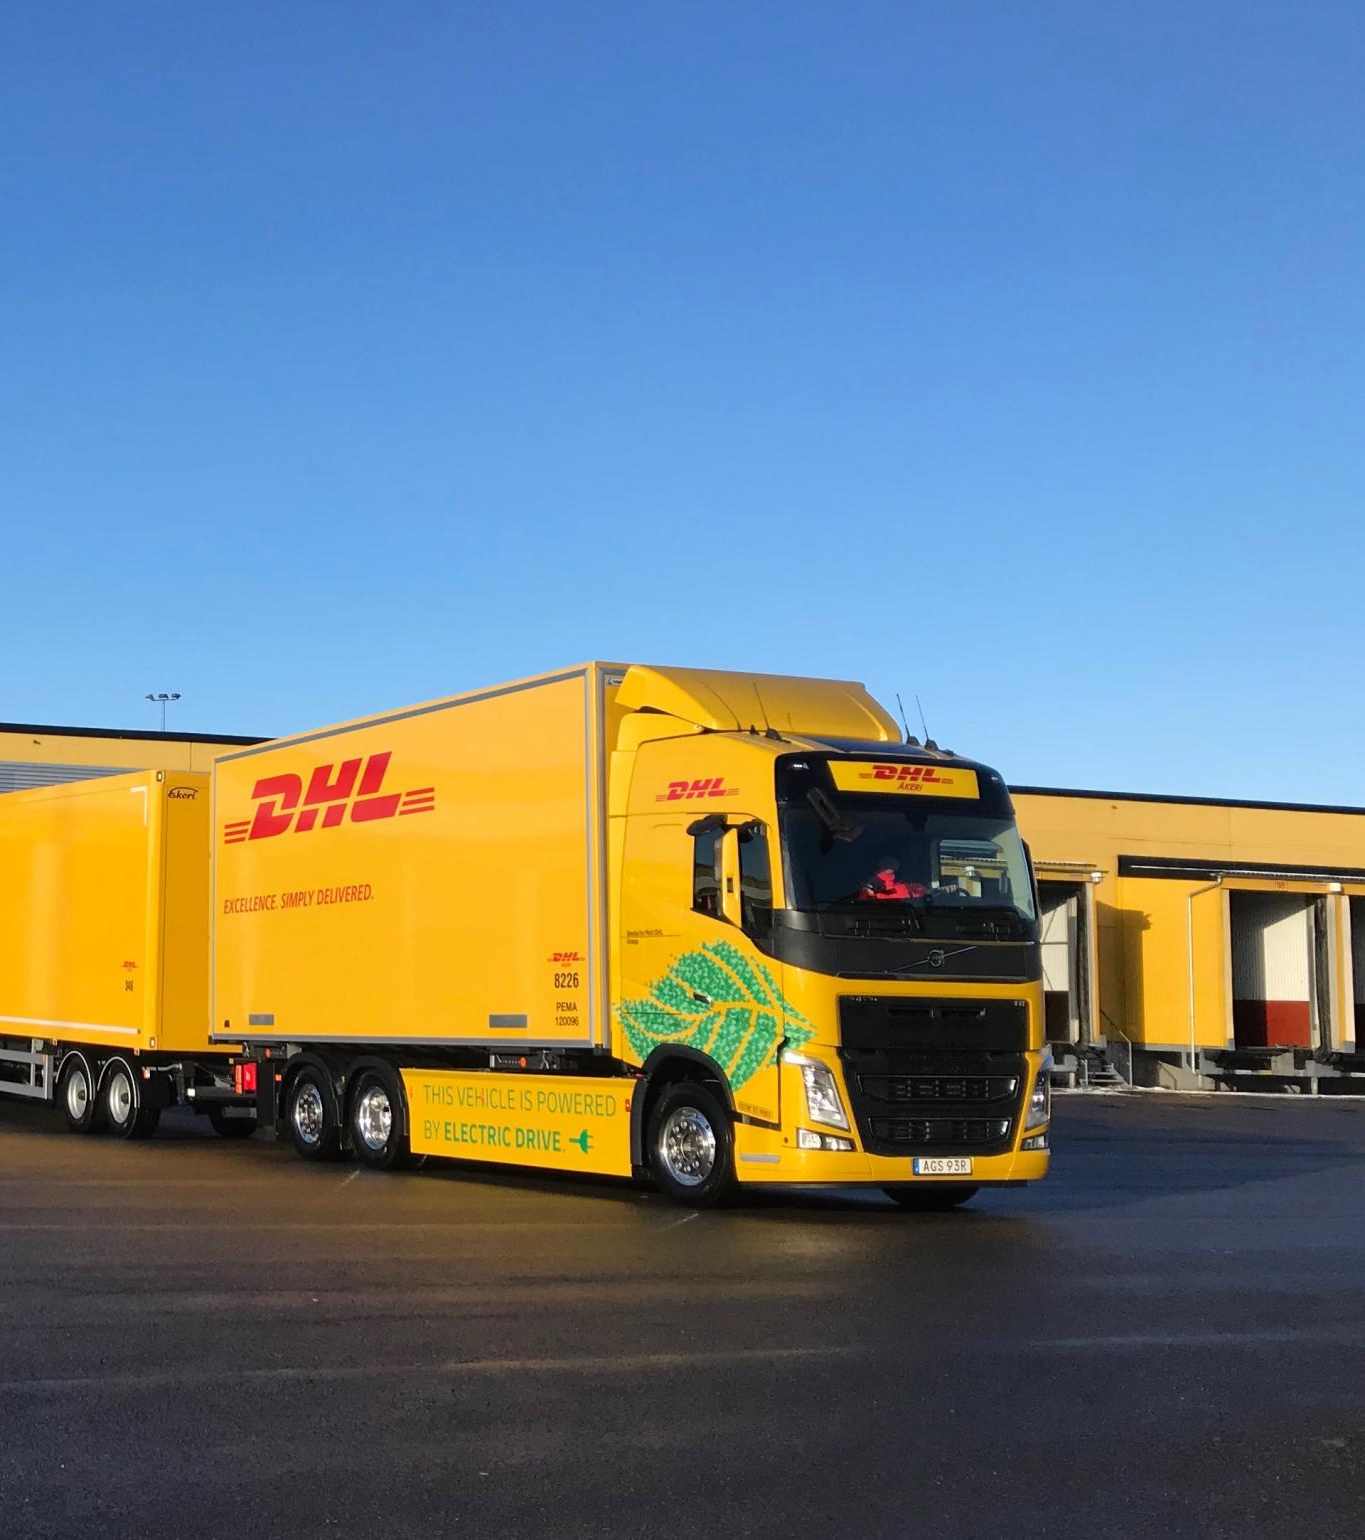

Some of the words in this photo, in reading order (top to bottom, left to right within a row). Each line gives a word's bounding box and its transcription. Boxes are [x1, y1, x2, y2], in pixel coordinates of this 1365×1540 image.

[872, 765, 940, 783] DHL
[248, 751, 402, 840] DHL
[667, 778, 726, 800] DHL
[280, 890, 315, 909] SIMPLY
[317, 883, 374, 906] DELIVERED.
[553, 951, 580, 962] DHL
[554, 972, 580, 989] 8226
[556, 1001, 578, 1012] PEMA
[555, 1016, 580, 1026] 120096
[423, 1084, 454, 1106] THIS
[456, 1086, 515, 1110] VEHICLE
[520, 1090, 533, 1112] IS
[537, 1091, 617, 1117] POWERED
[424, 1120, 440, 1140] BY
[444, 1122, 511, 1147] ELECTRIC
[924, 1160, 944, 1171] AGS
[946, 1160, 967, 1171] 93R
